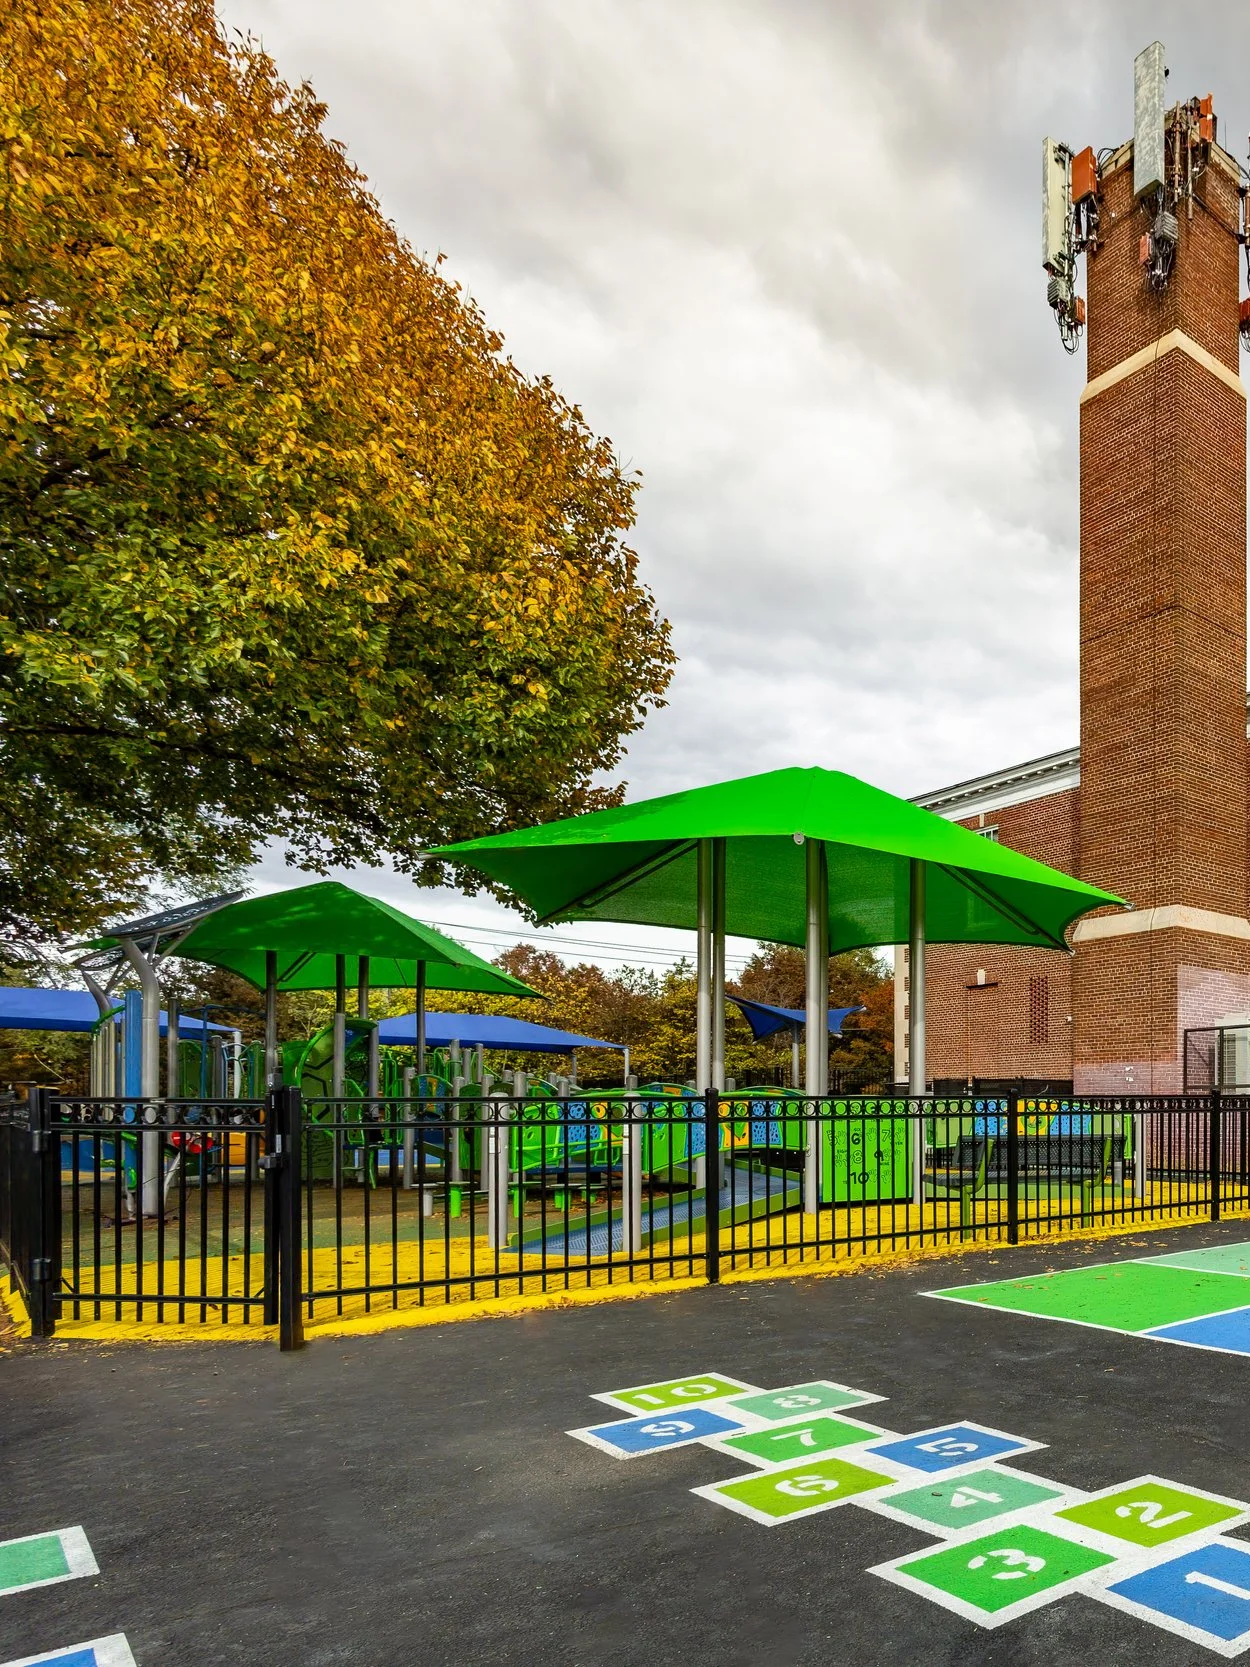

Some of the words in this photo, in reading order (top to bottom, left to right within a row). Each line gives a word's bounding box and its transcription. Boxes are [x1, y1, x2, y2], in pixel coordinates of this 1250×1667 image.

[851, 1132, 862, 1145] 6
[881, 1129, 891, 1142] 7
[853, 1149, 863, 1164] 8
[873, 1150, 884, 1162] 9
[850, 1171, 870, 1185] 10
[632, 1384, 718, 1405] 10
[772, 1394, 822, 1409] 8
[639, 1420, 696, 1437] 9
[771, 1428, 817, 1446] 7
[915, 1438, 979, 1457] 5
[775, 1475, 840, 1496] 6
[949, 1485, 1004, 1508] 4
[1115, 1501, 1194, 1528] 2
[967, 1548, 1046, 1580] 3
